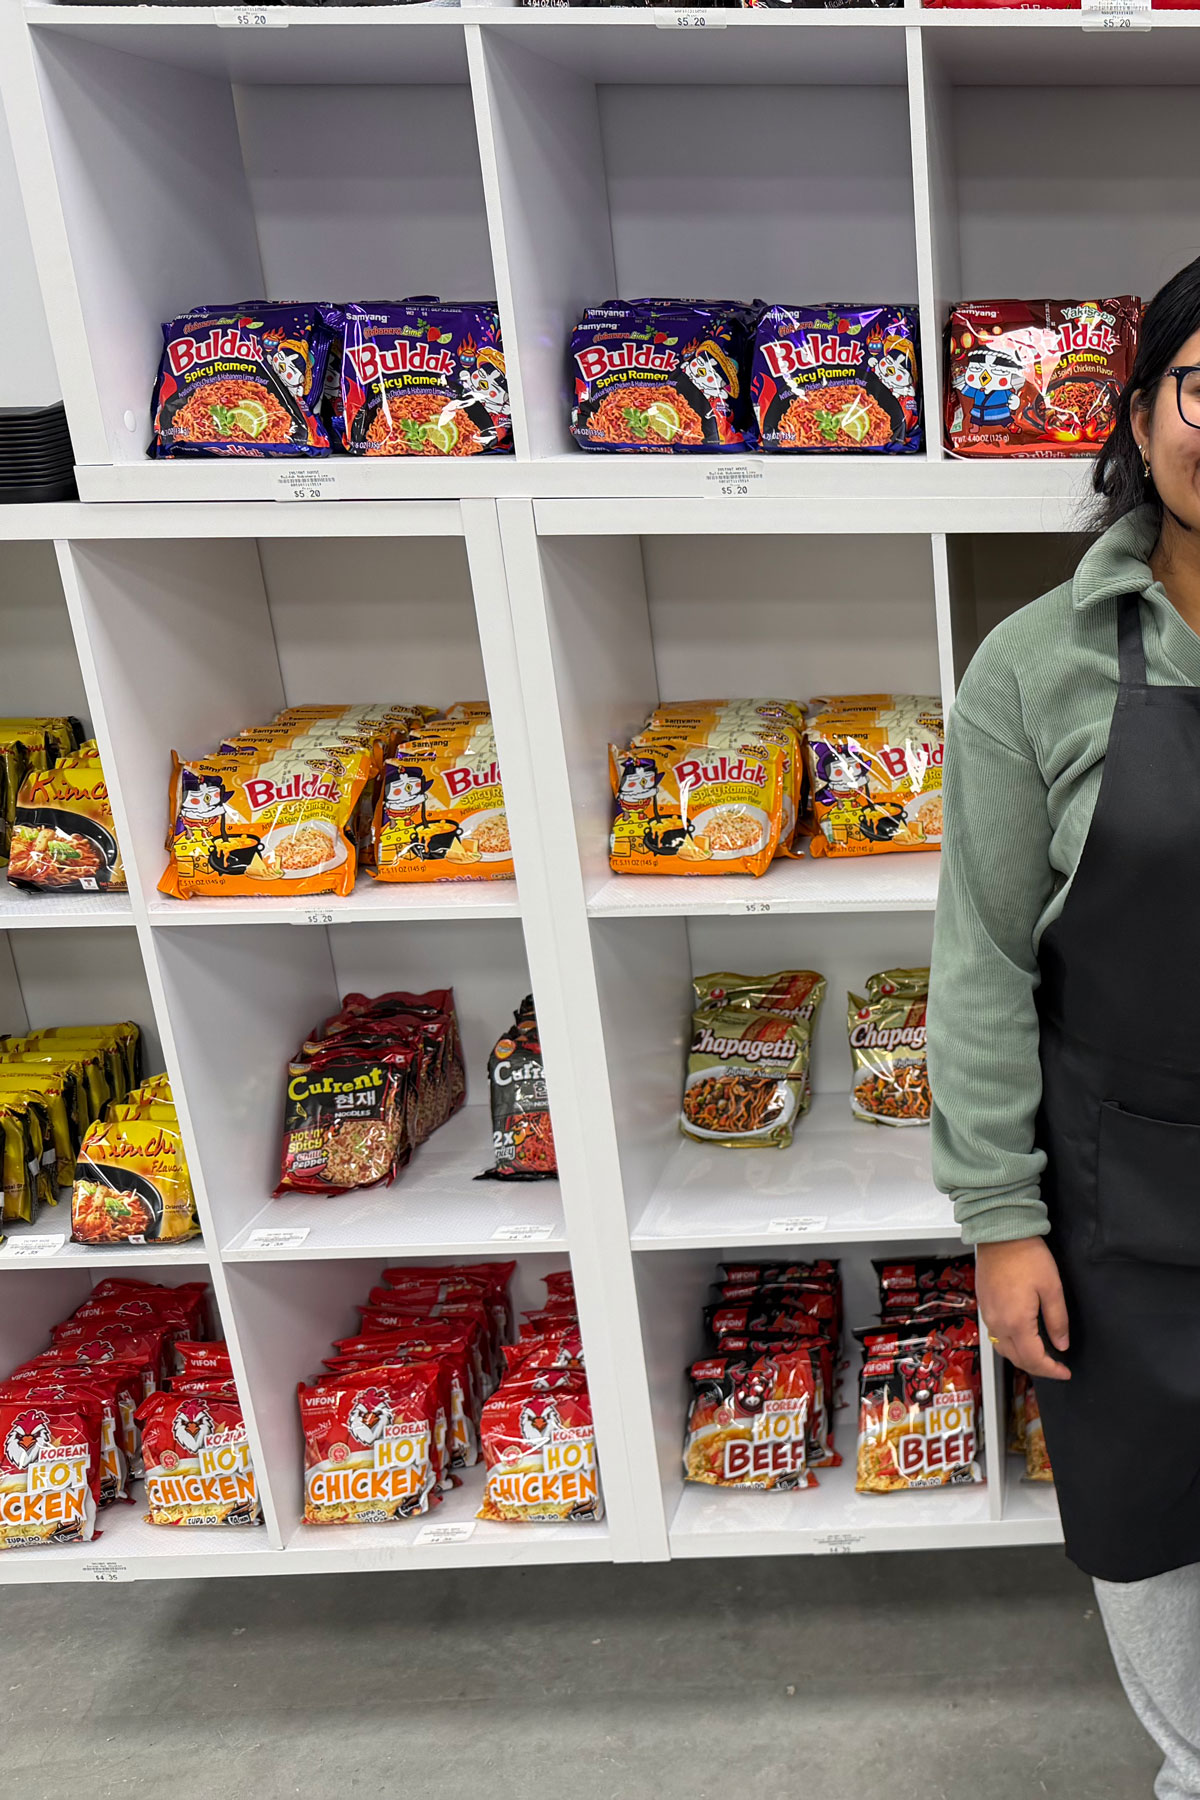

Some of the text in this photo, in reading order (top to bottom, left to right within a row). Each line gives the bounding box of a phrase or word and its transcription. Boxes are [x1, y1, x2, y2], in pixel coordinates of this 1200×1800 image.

[237, 15, 266, 25] $5.20
[677, 17, 706, 26] $5.20
[1103, 18, 1131, 28] $5.20
[346, 312, 388, 323] Samyang
[813, 319, 834, 330] Lime
[402, 325, 423, 337] Lime
[578, 322, 618, 331] Samyang
[167, 329, 264, 376] Buldak
[760, 333, 865, 378] Buldak
[1069, 352, 1107, 367] Ramen
[347, 340, 456, 384] Buldak
[574, 343, 679, 381] Buldak
[185, 361, 257, 383] Spicy Ramen
[817, 367, 856, 379] Ramen
[1073, 364, 1113, 377] Chicken Flavor
[372, 378, 403, 394] Spicy
[596, 370, 669, 388] Spicy Ramen
[989, 433, 1003, 443] (125
[294, 489, 321, 498] $5.20
[721, 486, 748, 495] $5.20
[412, 740, 449, 748] Samyang
[199, 764, 239, 773] Samyang
[672, 757, 768, 790] Buldak
[242, 773, 343, 811] Buldak
[460, 792, 492, 805] Spicy
[692, 785, 760, 801] Spicy Ramen
[460, 801, 496, 816] Artificial Spicy
[408, 865, 420, 873] (145
[640, 859, 653, 867] (145
[746, 903, 771, 912] $5.20
[308, 914, 333, 923] $5.20
[850, 1022, 927, 1051] Chapag
[692, 1028, 797, 1062] Chapagetti
[288, 1067, 383, 1101] Current
[335, 1091, 376, 1109] 현재
[335, 1110, 371, 1118] NOODLES
[715, 1319, 742, 1328] VIFON
[306, 1397, 335, 1406] VIFON
[758, 1415, 800, 1440] HOT
[929, 1407, 973, 1434] HOT
[385, 1423, 428, 1437] KOREAN
[40, 1445, 87, 1460] KOREAN
[379, 1437, 427, 1467] HOT
[548, 1443, 594, 1470] HOT
[725, 1442, 804, 1475] BEEF
[903, 1435, 974, 1470] BEEF
[203, 1445, 250, 1475] HOT
[32, 1462, 86, 1490] HOT
[310, 1465, 427, 1502] CHICKEN
[149, 1472, 257, 1504] CHICKEN
[488, 1470, 598, 1503] CHICKEN
